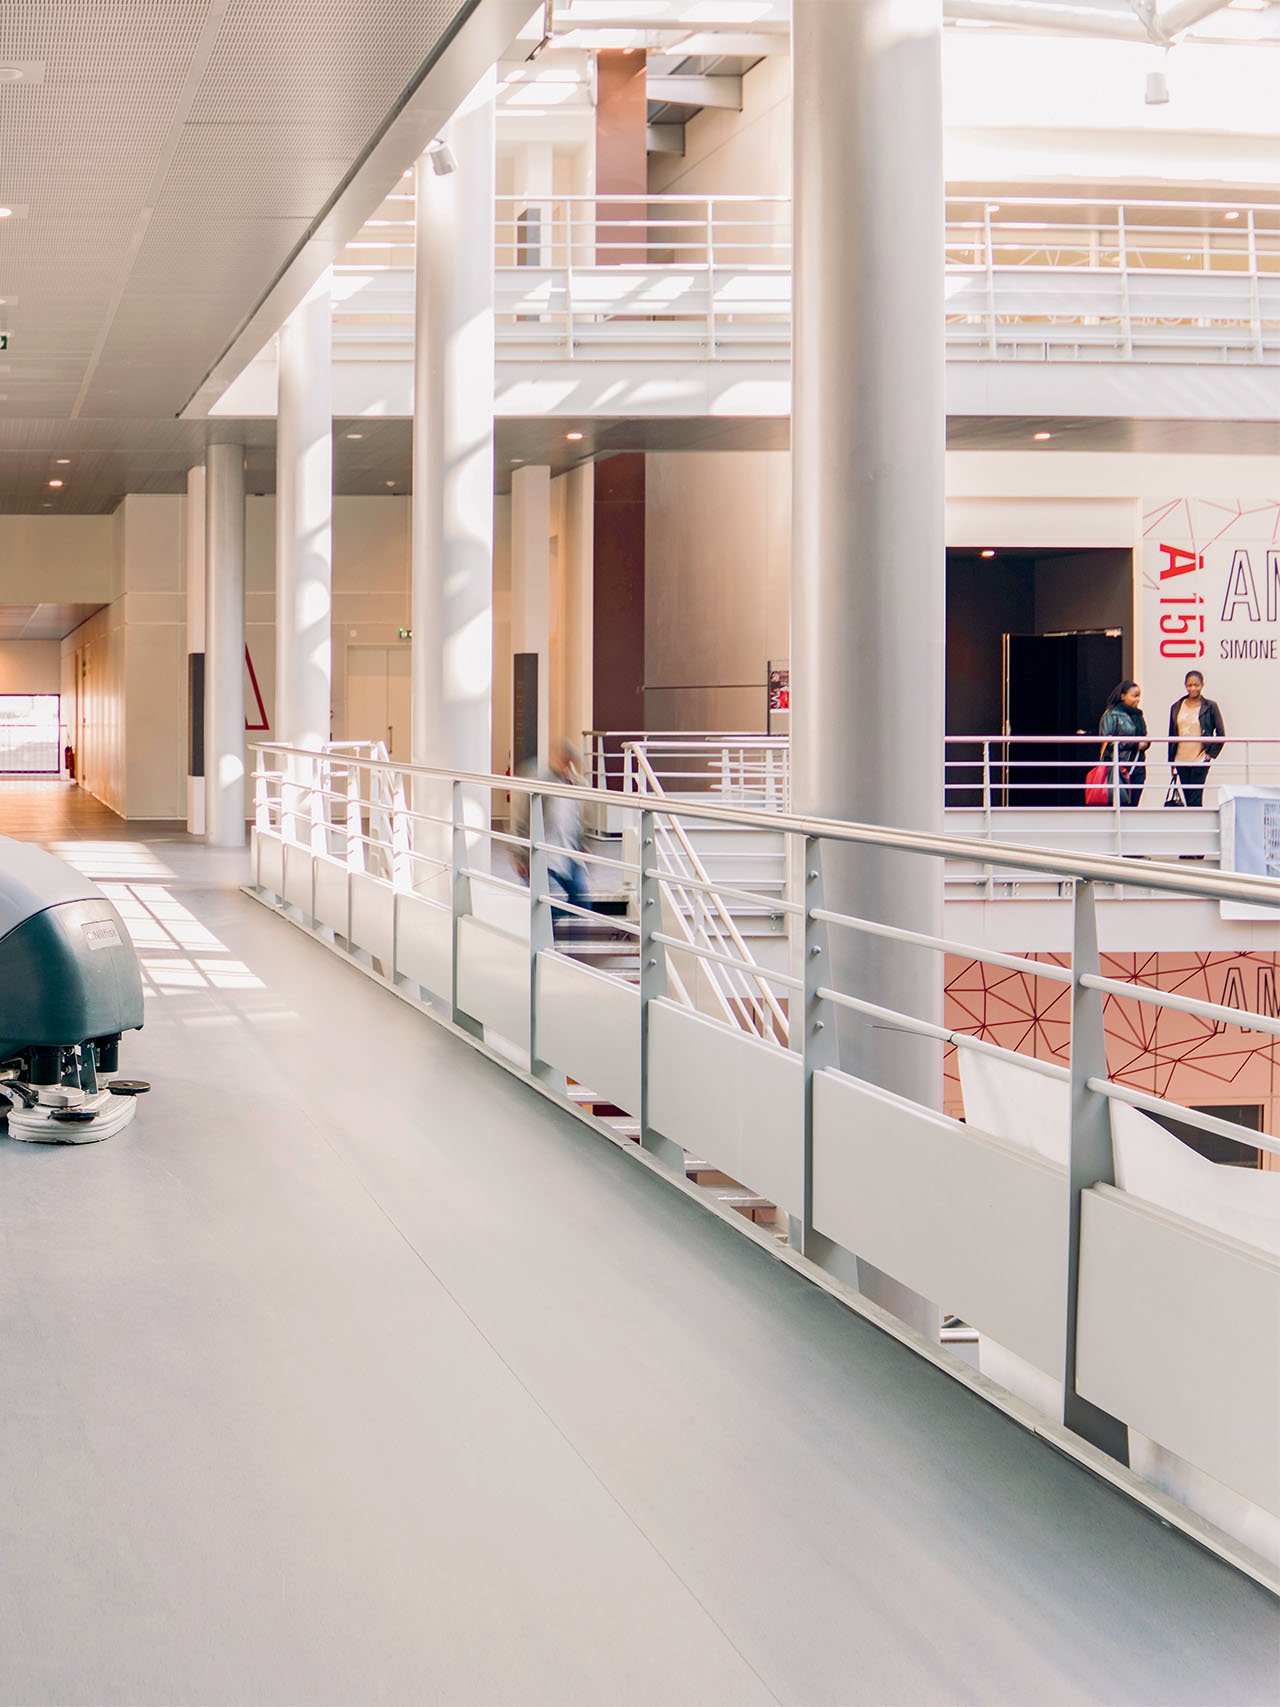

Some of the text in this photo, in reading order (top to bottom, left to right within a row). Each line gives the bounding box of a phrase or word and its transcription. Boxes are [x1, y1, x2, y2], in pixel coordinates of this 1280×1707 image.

[1160, 543, 1205, 658] A 150
[1220, 639, 1278, 660] SIMONE
